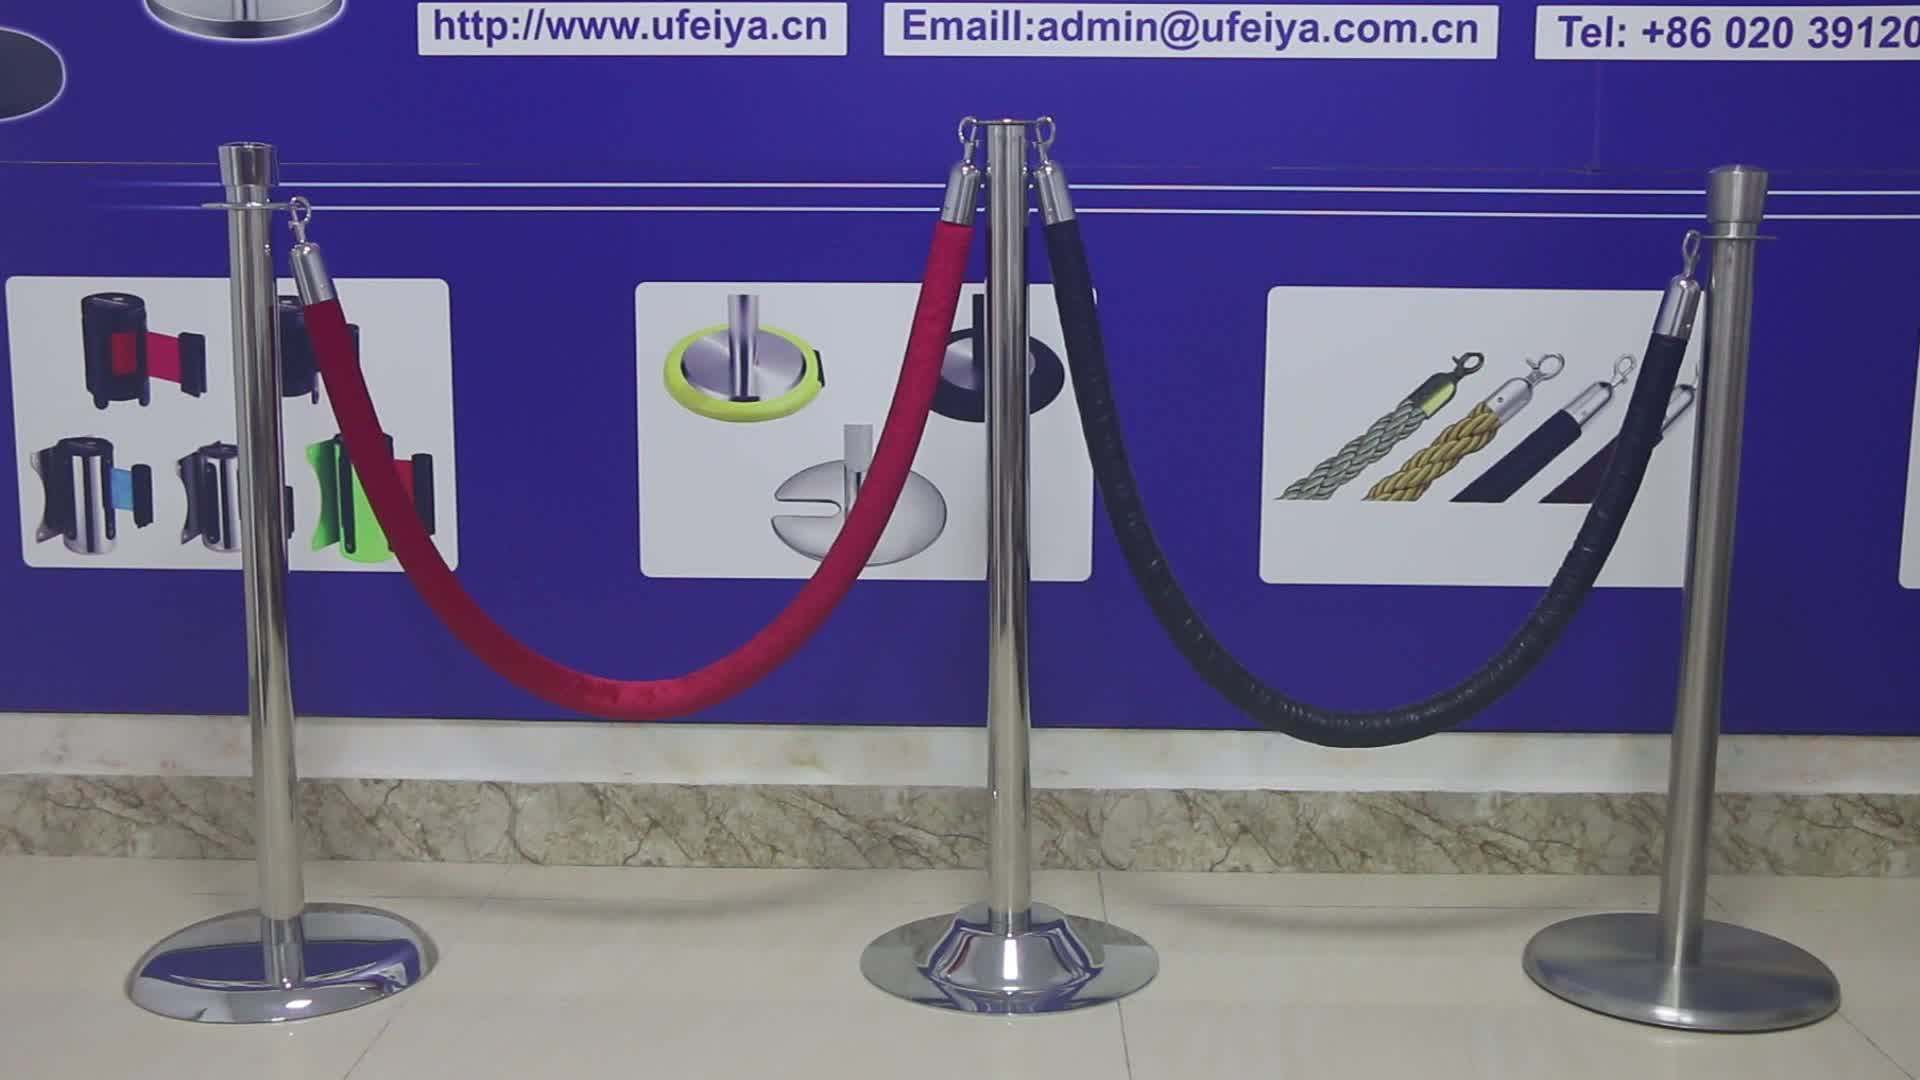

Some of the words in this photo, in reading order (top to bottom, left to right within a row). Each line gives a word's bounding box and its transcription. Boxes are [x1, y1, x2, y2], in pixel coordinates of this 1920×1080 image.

[434, 8, 828, 49] http://www.ufeiya.cn
[903, 9, 1479, 52] Emaill:admin@ufeiya.com.cn
[1557, 15, 1626, 49] Tel:
[1641, 15, 1712, 49] +86
[1725, 15, 1794, 50] 020
[1807, 15, 1920, 50] 39120
